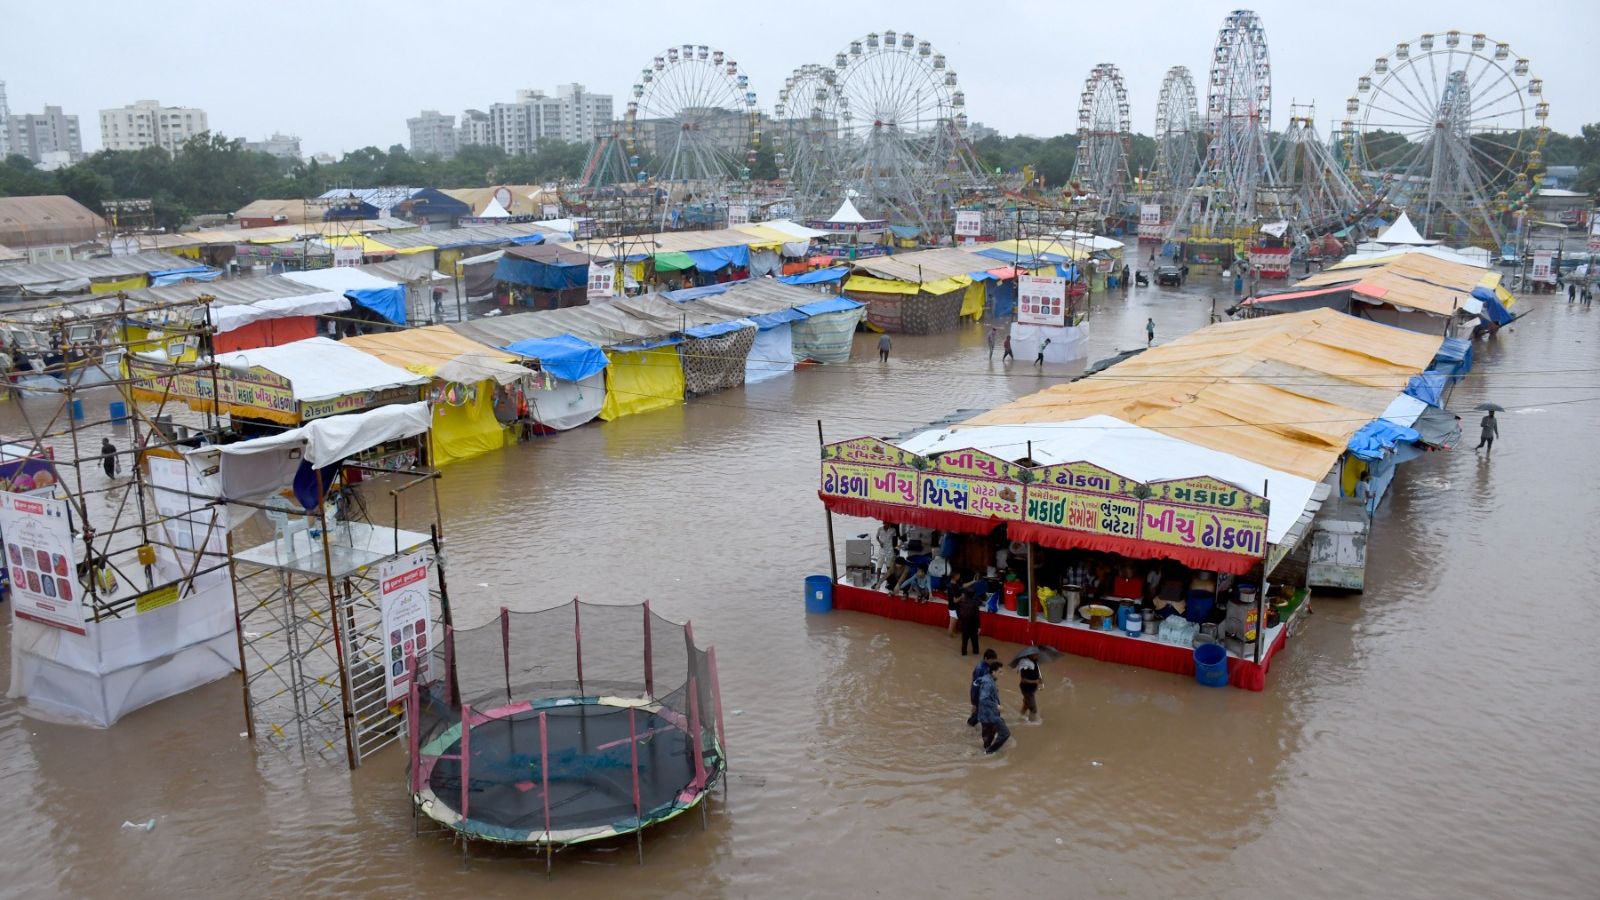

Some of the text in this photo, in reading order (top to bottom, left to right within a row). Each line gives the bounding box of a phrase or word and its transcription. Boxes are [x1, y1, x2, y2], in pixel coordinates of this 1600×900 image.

[304, 405, 334, 418] ઢોકળા
[944, 454, 997, 476] ખીચુ
[824, 465, 914, 502] ઢોકળા ખીચુ
[1056, 468, 1110, 490] ઢોકળા
[923, 478, 968, 510] ચિપ્સ
[972, 483, 997, 496] પોટેટો
[1174, 488, 1237, 506] મકાઈ
[971, 497, 1020, 513] ટ્વિસ્ટર
[1028, 498, 1066, 524] મકાઈ
[1100, 500, 1136, 516] ભુંગળા
[1102, 515, 1134, 534] બટેટા
[1146, 510, 1260, 553] ખીચુ ઢોકળા
